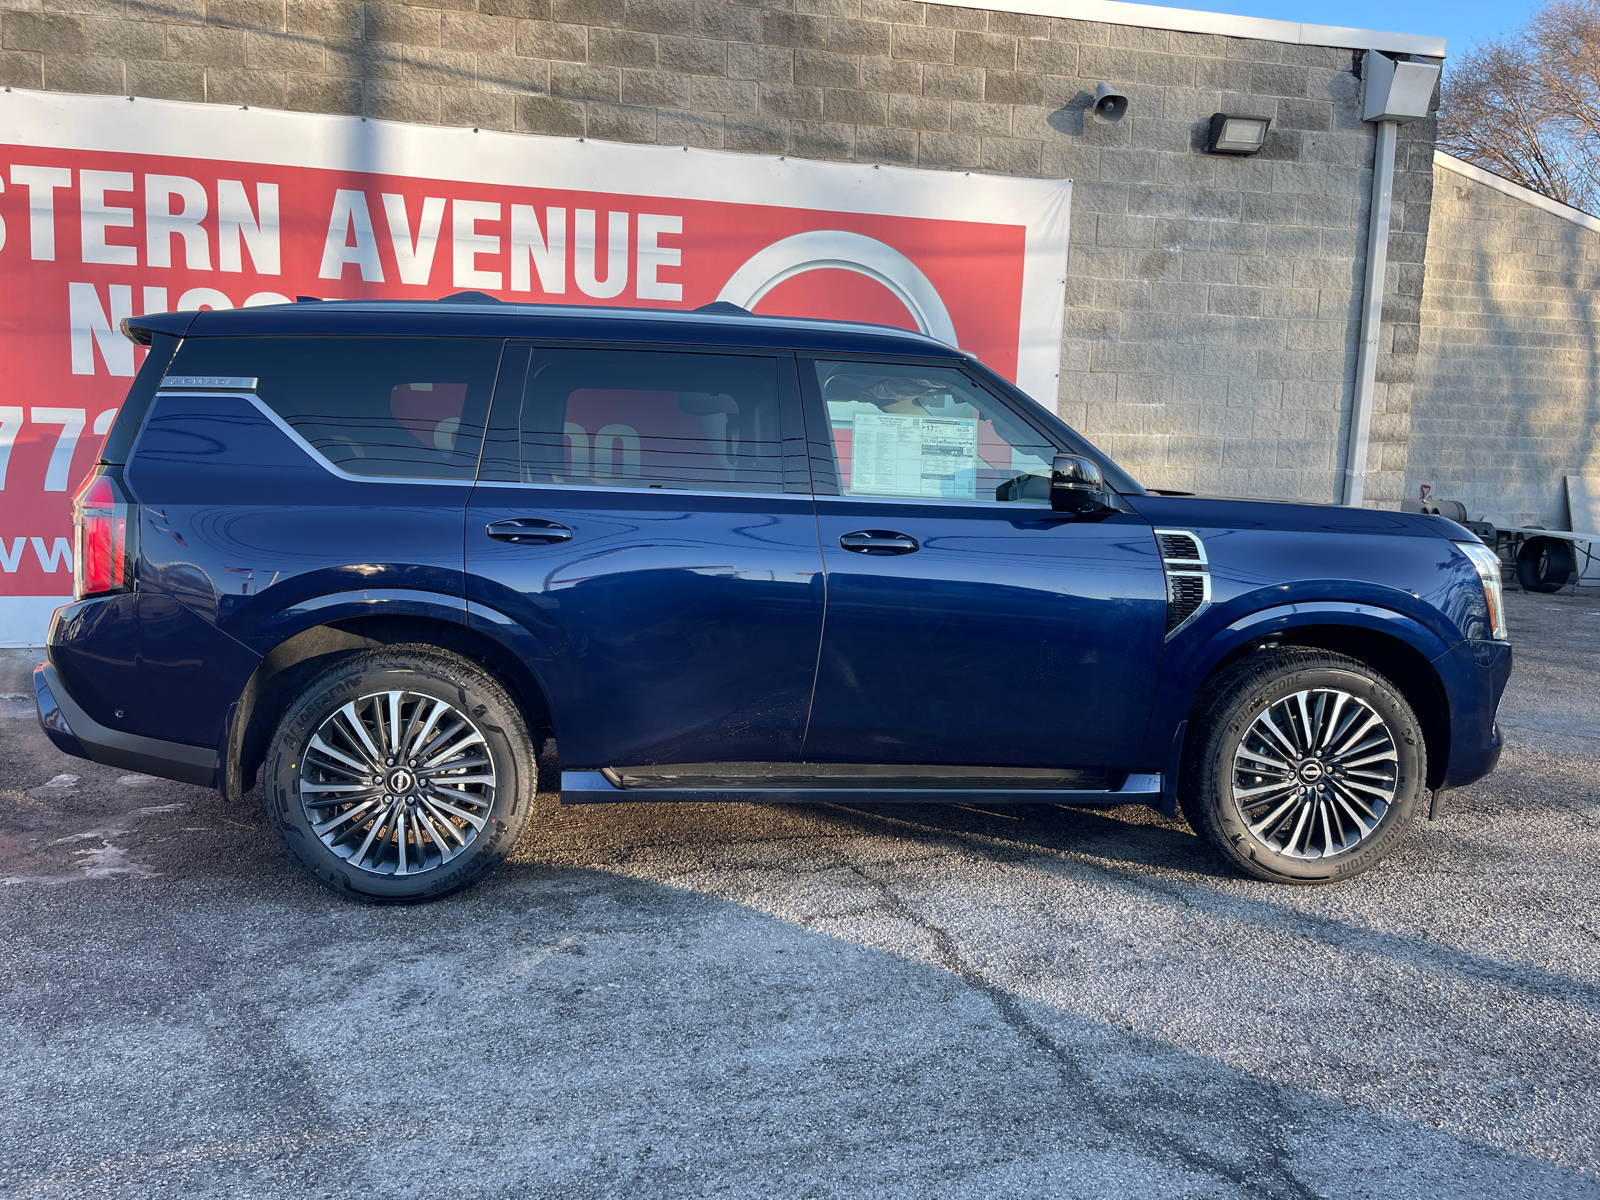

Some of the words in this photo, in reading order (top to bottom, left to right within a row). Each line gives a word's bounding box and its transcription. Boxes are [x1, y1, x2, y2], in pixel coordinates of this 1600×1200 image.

[0, 164, 281, 276] TERN
[318, 188, 684, 302] AVENUE
[1228, 674, 1302, 737] BRIDGESTONE
[1335, 814, 1407, 875] BRIDGESTONE
